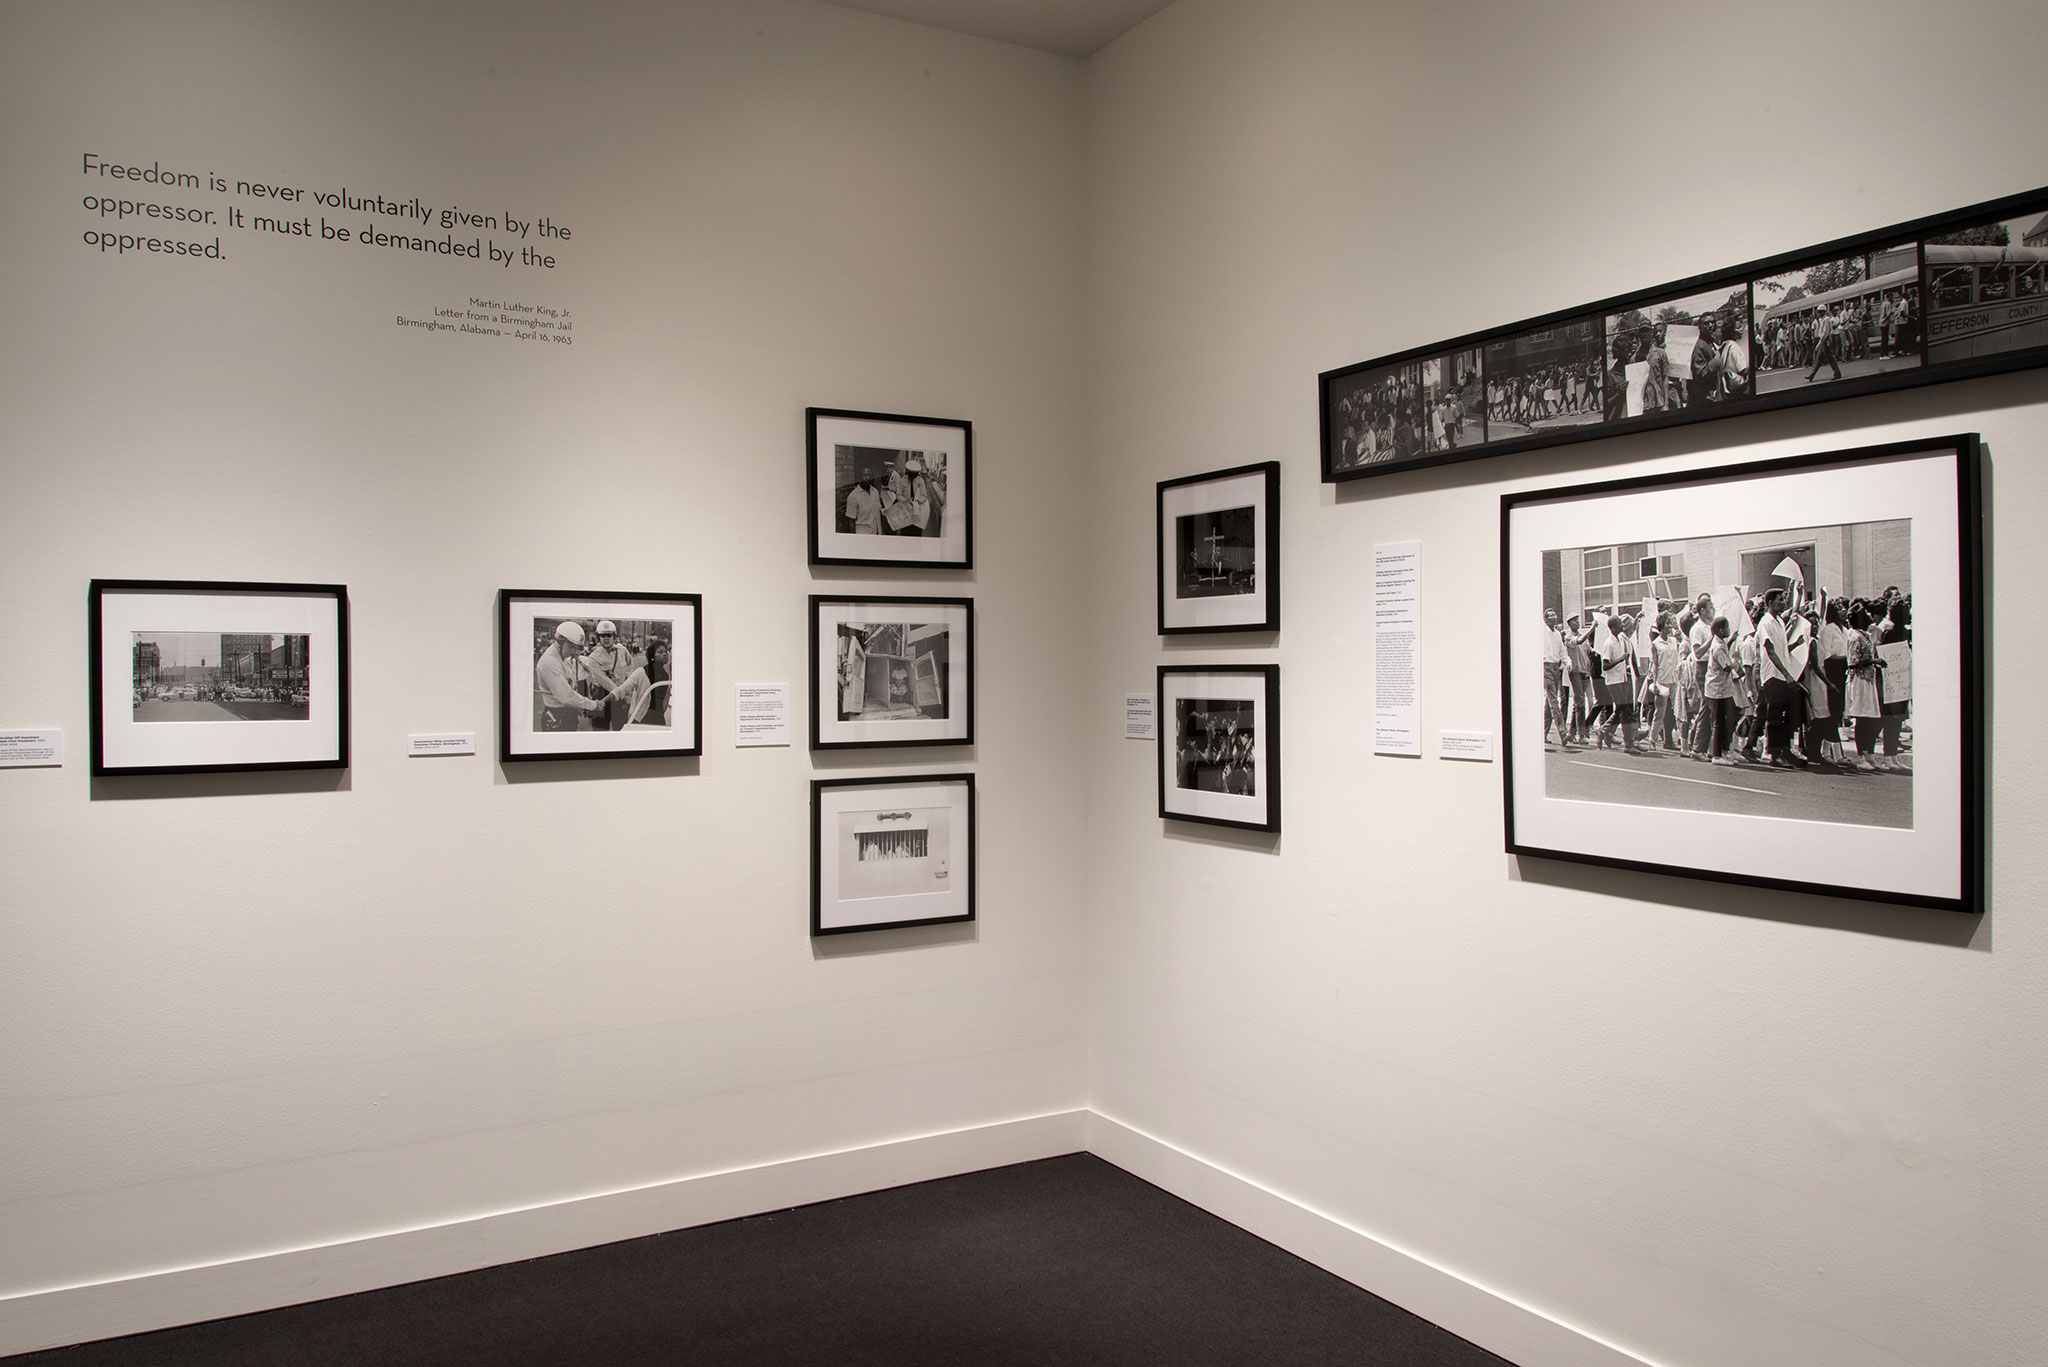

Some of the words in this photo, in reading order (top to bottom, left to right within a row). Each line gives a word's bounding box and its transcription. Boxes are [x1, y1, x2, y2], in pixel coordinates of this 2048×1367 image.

[83, 152, 200, 190] Freedom
[209, 171, 228, 193] is
[236, 181, 305, 203] never
[312, 186, 433, 226] voluntarily
[439, 205, 497, 230] given
[504, 210, 531, 240] by
[538, 218, 572, 241] the
[82, 195, 217, 226] oppressor.
[228, 205, 245, 229] It
[253, 216, 313, 238] must
[320, 216, 351, 242] be
[359, 223, 481, 259] demanded
[488, 239, 515, 269] by
[521, 246, 556, 269] the
[82, 230, 227, 261] oppressed.
[434, 306, 464, 319] Letter
[466, 309, 490, 322] from
[491, 315, 498, 323] a
[500, 313, 555, 330] Birmingham
[557, 320, 573, 331] Jail
[469, 297, 501, 310] Martin
[503, 300, 535, 314] Luther
[560, 309, 572, 318] Jr.
[1927, 313, 1990, 336] JEFFERSON
[2008, 305, 2039, 319] COUNTY
[396, 315, 457, 333] Birmingham,
[459, 323, 501, 337] Alabama
[514, 329, 538, 343] April
[539, 332, 551, 343] 16,
[552, 334, 573, 346] 1963
